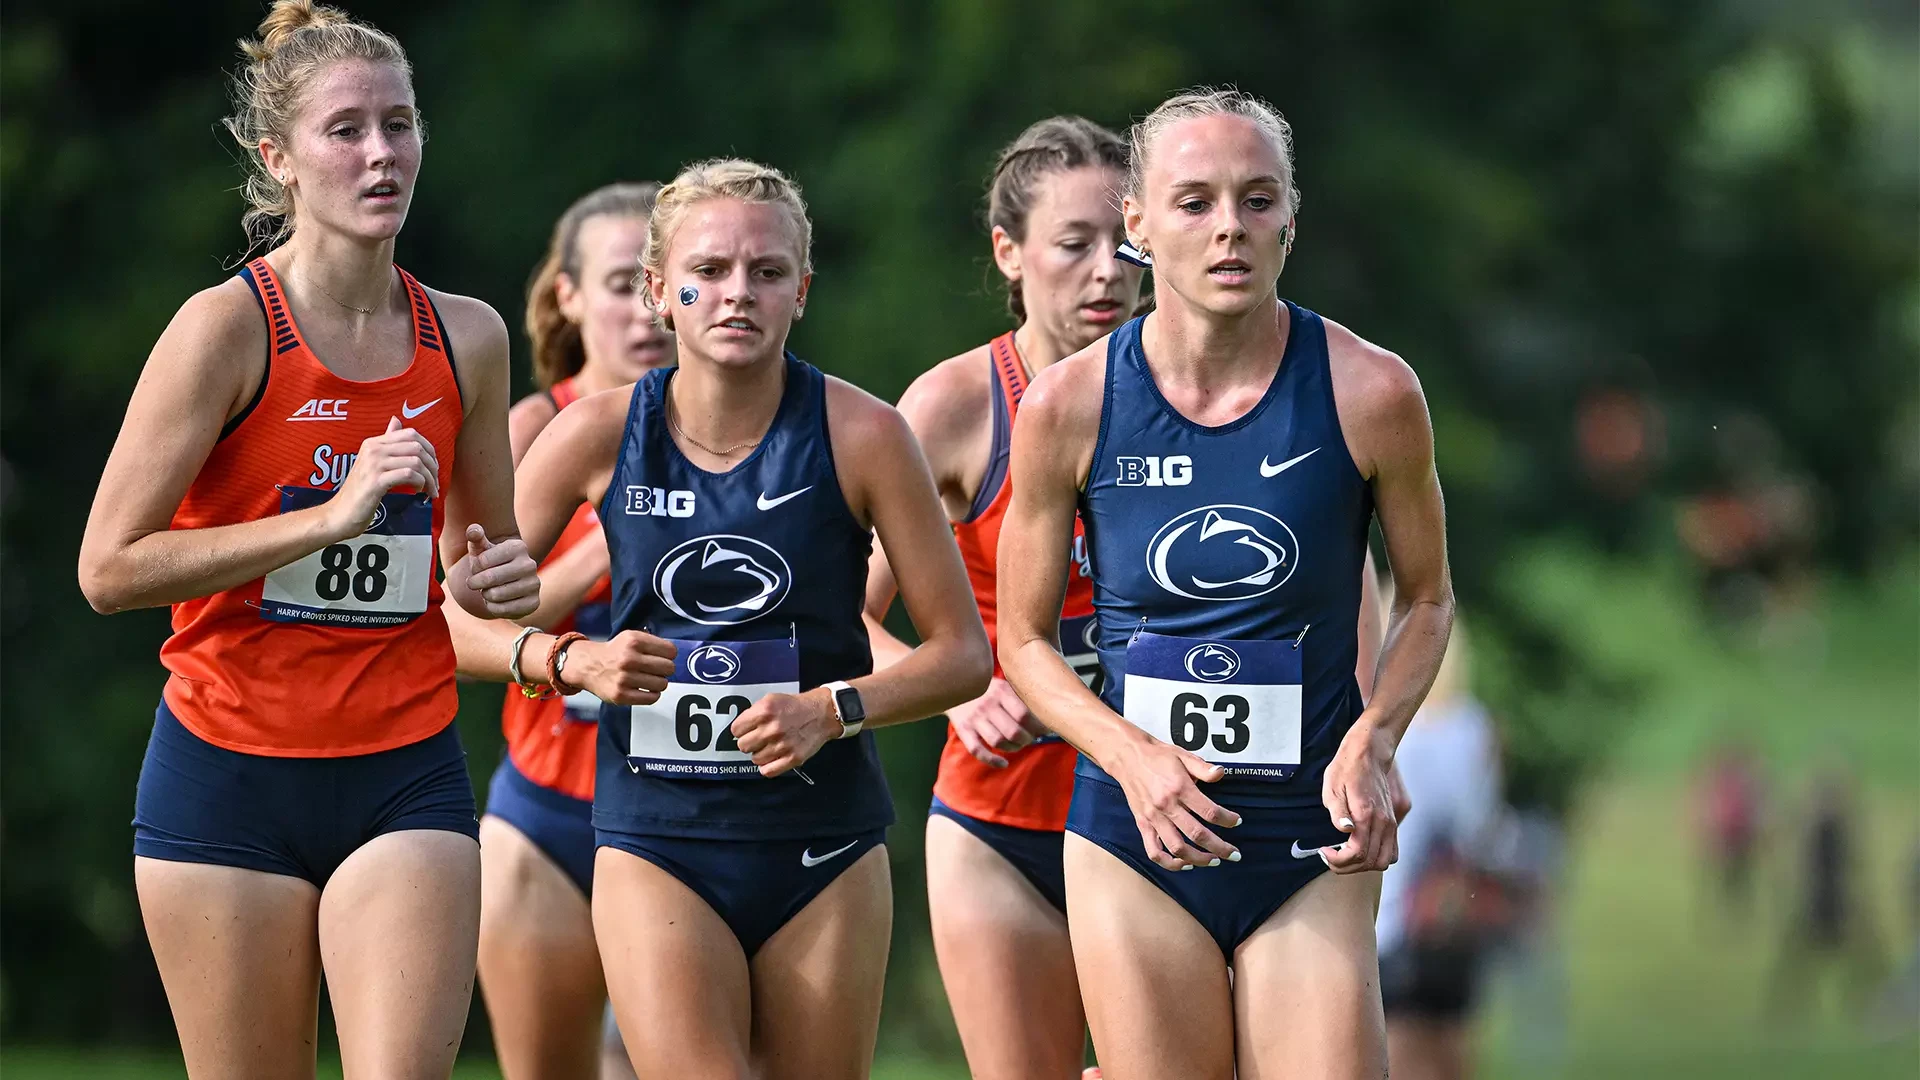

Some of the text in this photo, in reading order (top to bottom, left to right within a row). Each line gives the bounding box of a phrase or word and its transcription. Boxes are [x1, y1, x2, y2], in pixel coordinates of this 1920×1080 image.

[292, 399, 350, 417] ACC
[315, 543, 390, 602] 88
[277, 607, 301, 618] HARRY
[301, 611, 327, 621] GROVES
[327, 613, 350, 623] SPIKED
[351, 615, 368, 624] SHOE
[675, 694, 752, 752] 62
[1170, 692, 1250, 753] 63
[645, 762, 760, 774] HARRY GROVES SPIKED SHOE INVITA
[1223, 767, 1283, 777] OE INVITATIONAL
